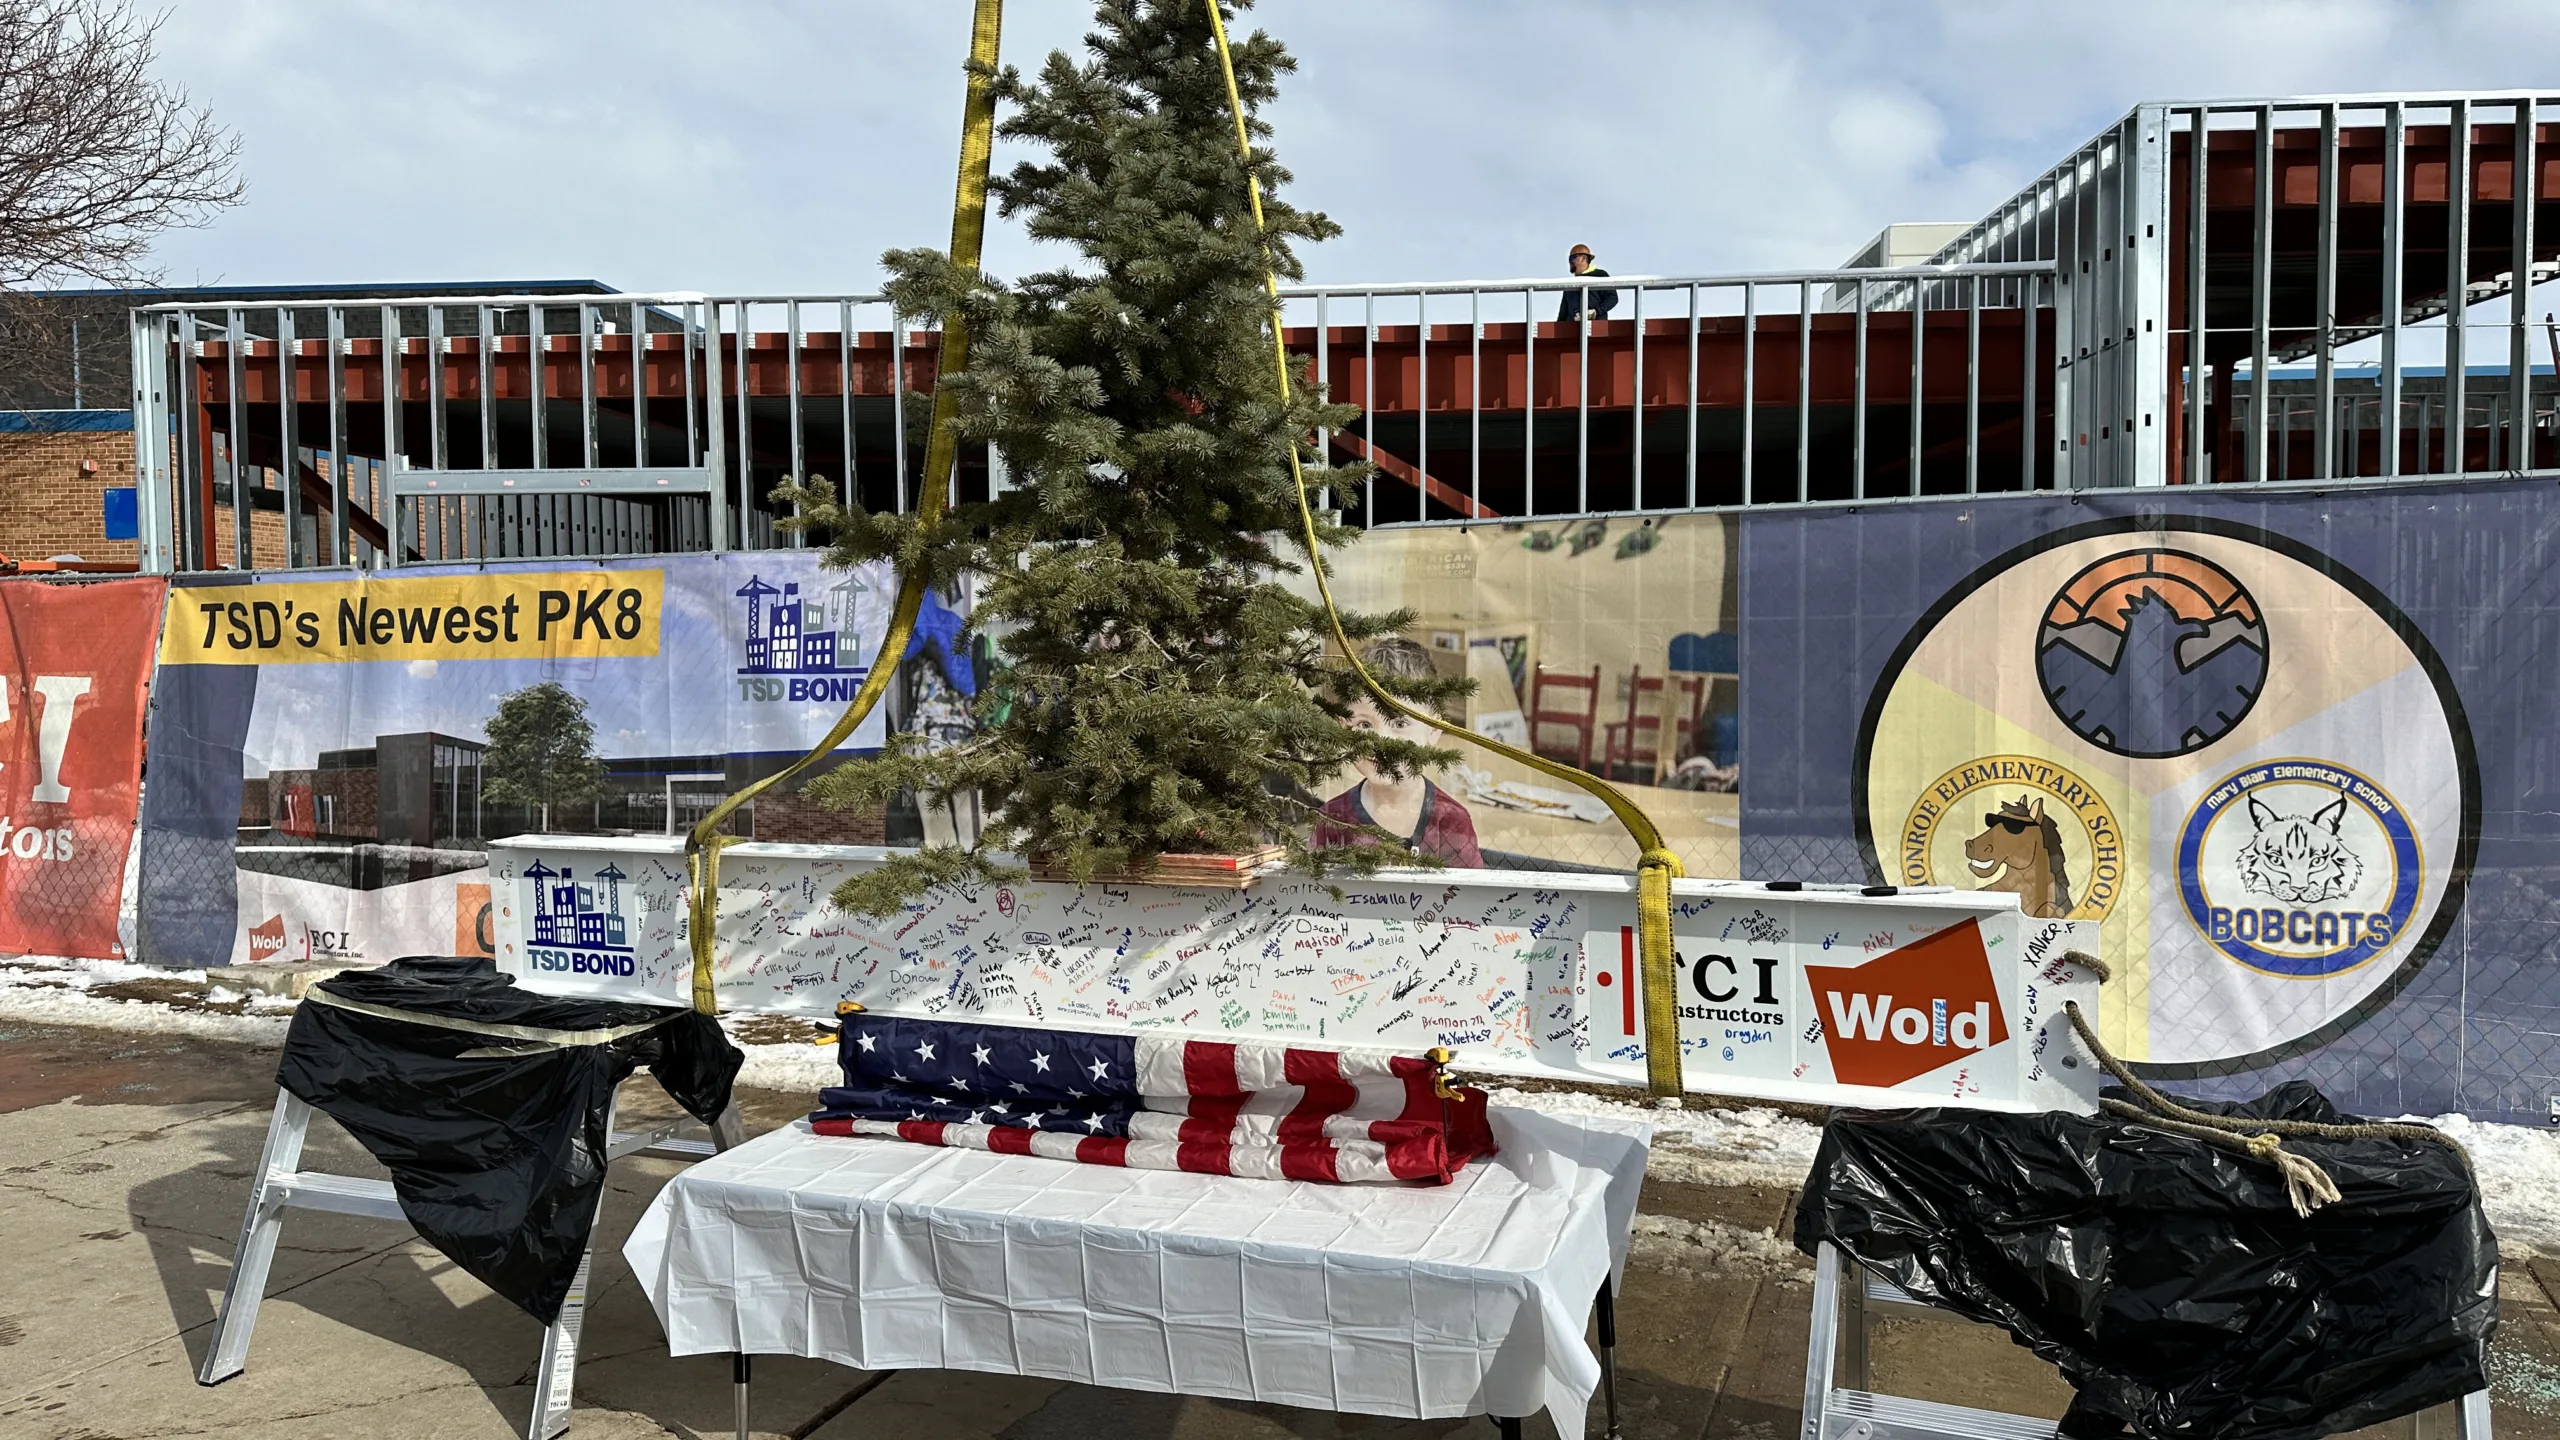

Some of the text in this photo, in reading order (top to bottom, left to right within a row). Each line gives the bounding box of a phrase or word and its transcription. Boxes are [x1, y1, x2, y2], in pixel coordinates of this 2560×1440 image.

[200, 587, 643, 650] TSD's Newest PK8
[737, 678, 785, 702] TSD
[2272, 765, 2352, 789] Elementary
[1906, 761, 2118, 911] ONROE ELEMENTARY SCHOOL
[1300, 903, 1345, 921] Anwar
[677, 917, 688, 941] Noah
[1138, 925, 1180, 938] Bailee
[2209, 906, 2393, 949] BOBCATS
[252, 934, 284, 950] Wold
[310, 930, 350, 950] FCI
[527, 949, 570, 972] TSD
[572, 952, 635, 977] BOND
[1148, 960, 1172, 981] Gavin
[1675, 951, 1779, 1005] CI
[1677, 1003, 1784, 1026] nstructors
[1826, 990, 1990, 1050] Wold
